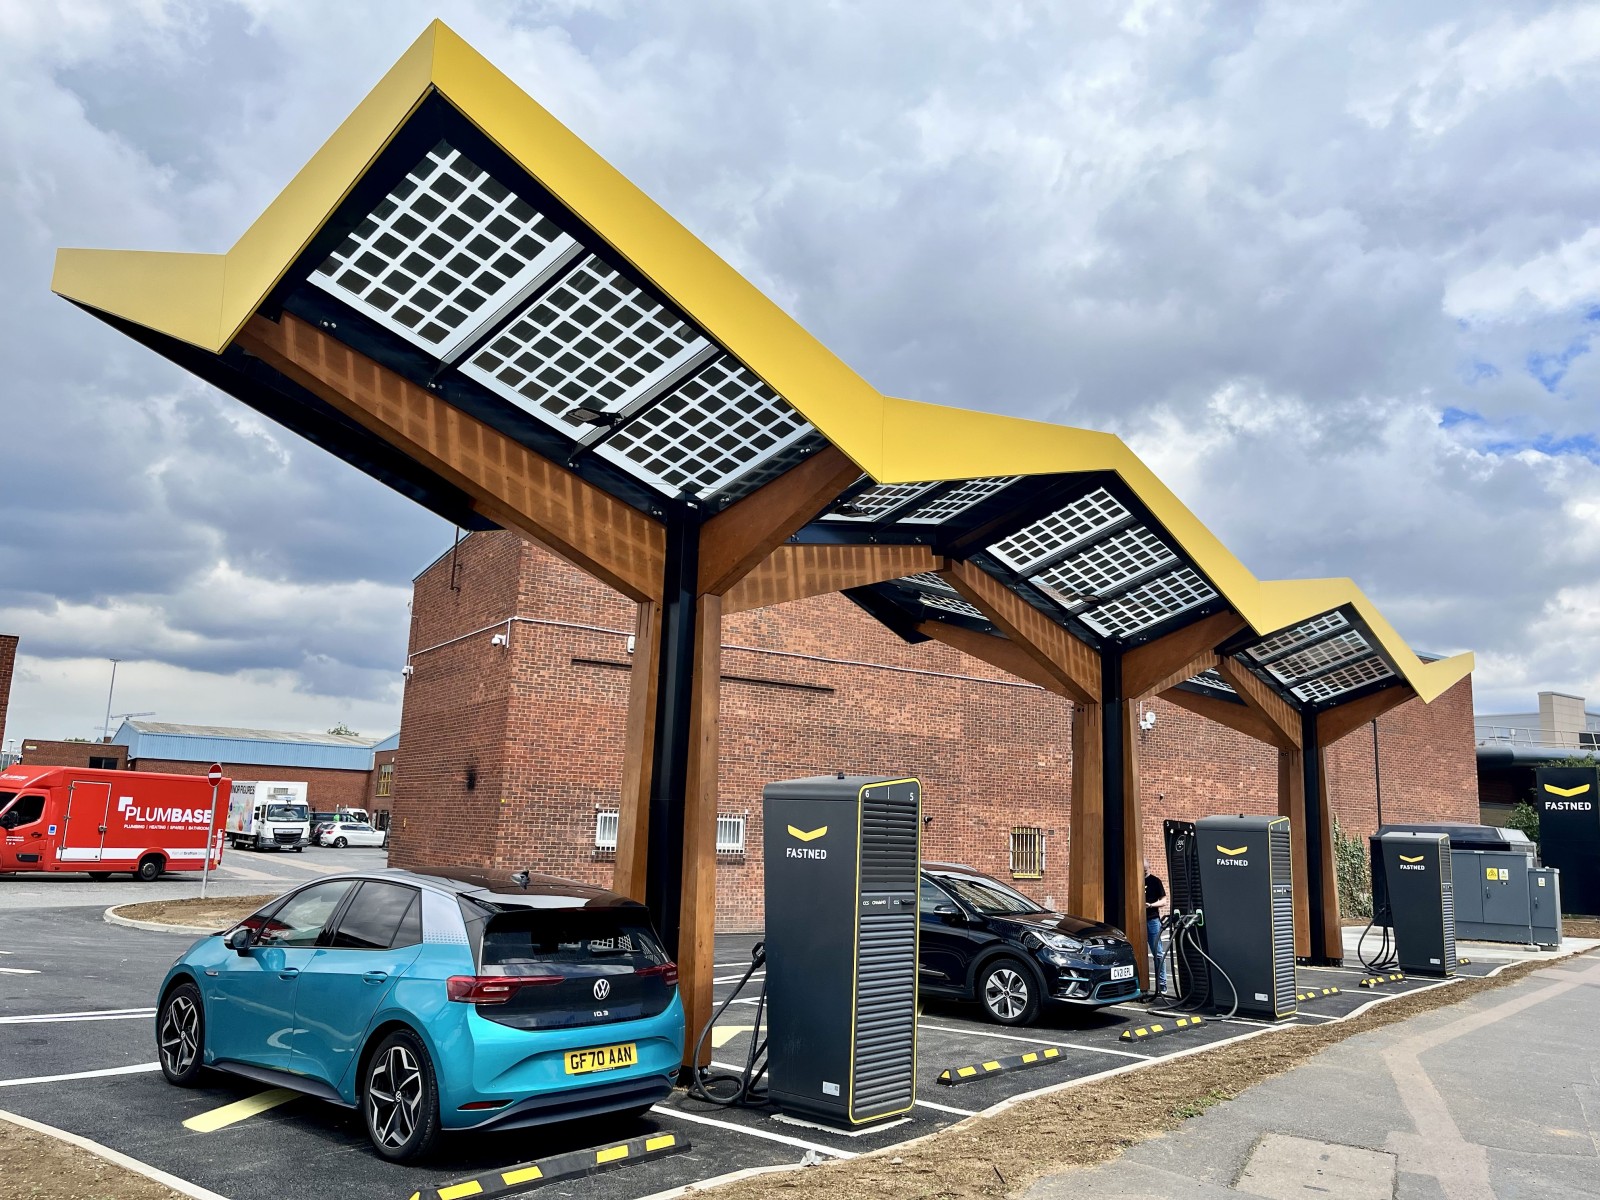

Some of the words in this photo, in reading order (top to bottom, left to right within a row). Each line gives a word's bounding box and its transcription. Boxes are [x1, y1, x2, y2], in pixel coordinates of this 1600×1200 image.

[865, 790, 870, 798] 6
[909, 792, 914, 801] 5
[1545, 802, 1591, 811] FASTNED
[125, 806, 213, 824] PLUMBASE
[786, 848, 827, 860] FASTNED
[1216, 858, 1248, 867] FASTNED
[571, 1050, 605, 1070] GF70
[609, 1046, 632, 1065] AAN
